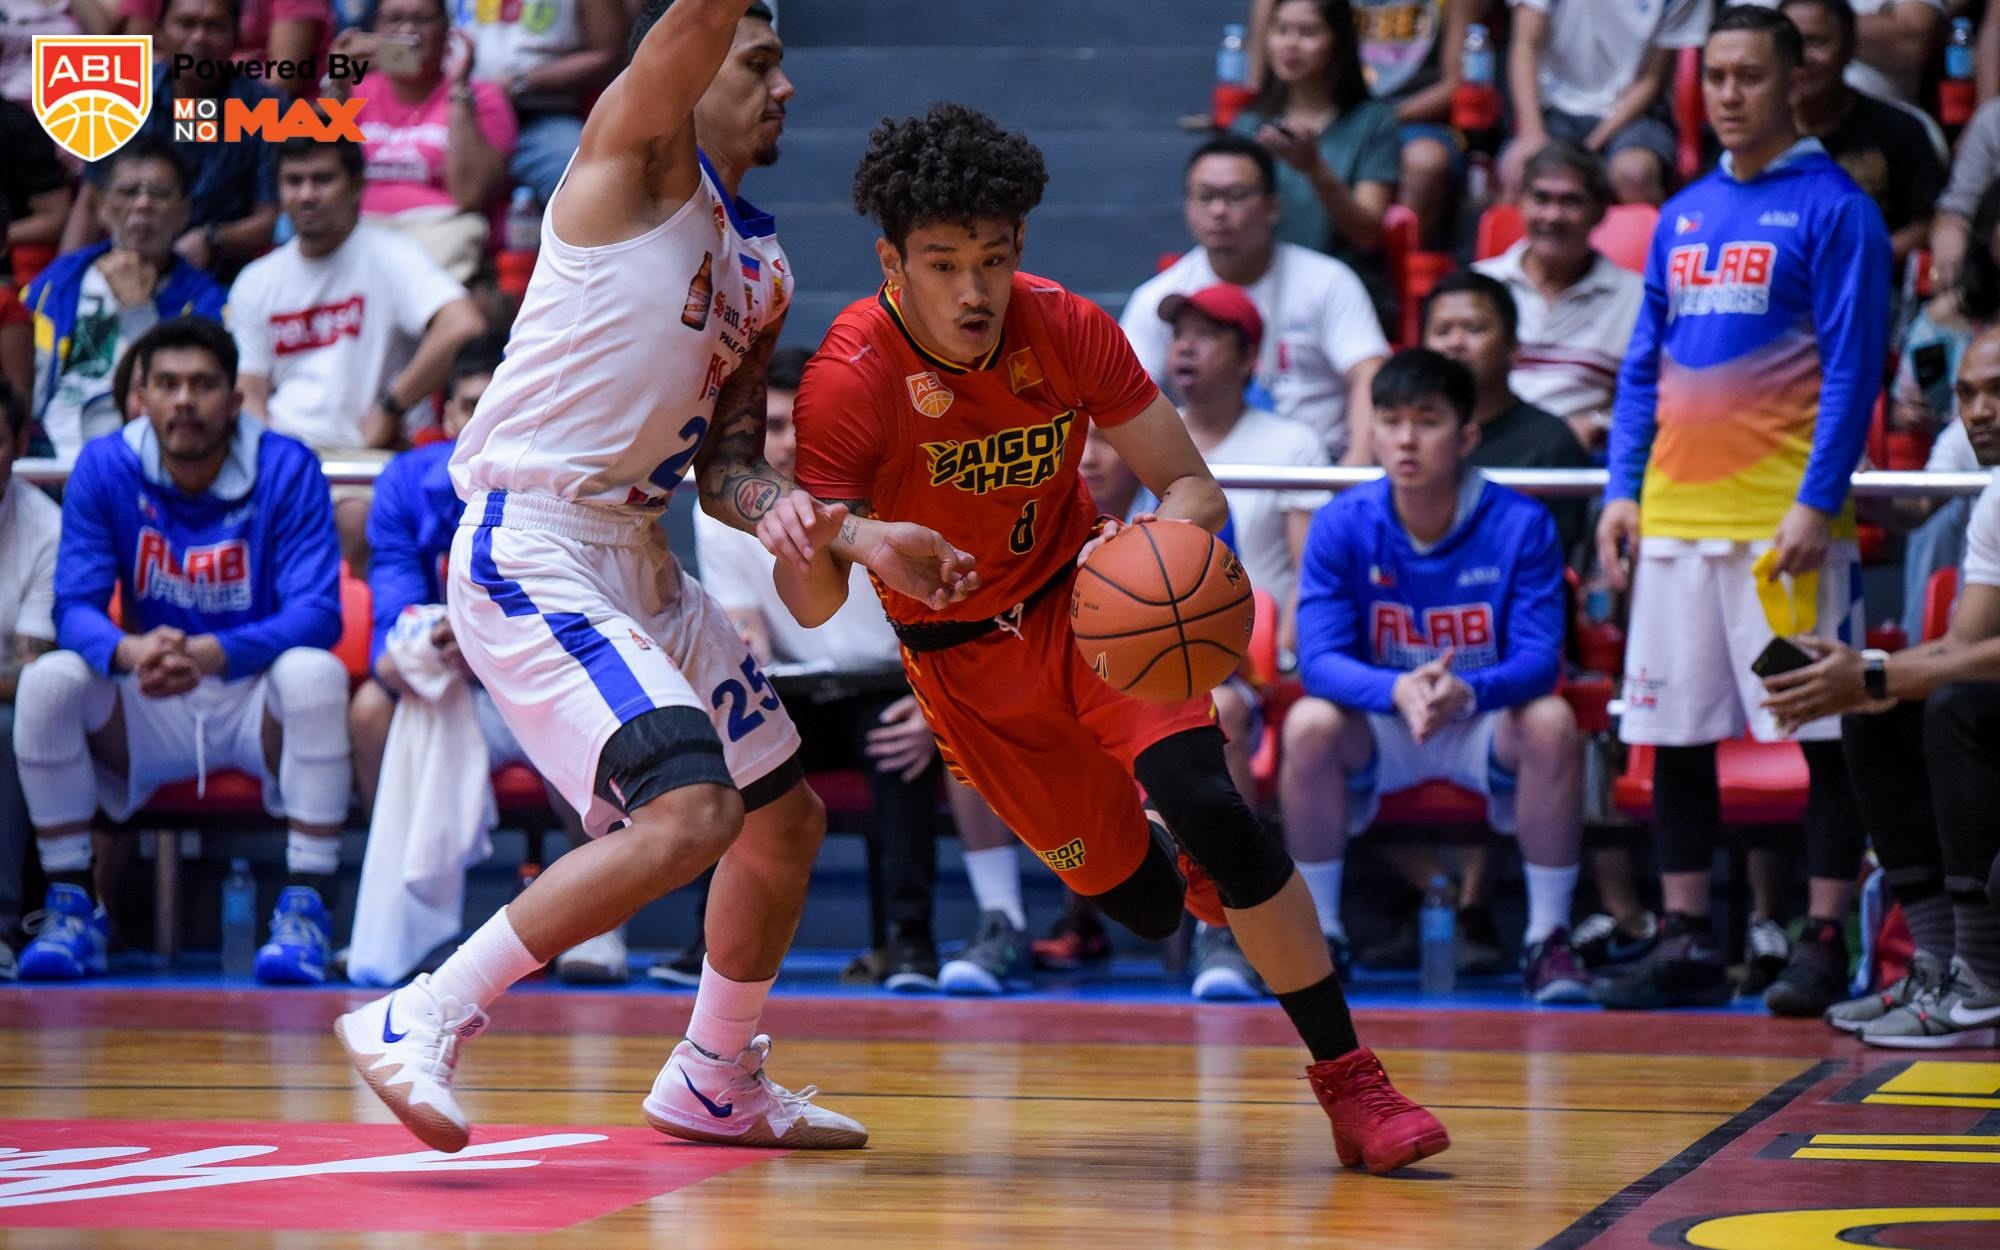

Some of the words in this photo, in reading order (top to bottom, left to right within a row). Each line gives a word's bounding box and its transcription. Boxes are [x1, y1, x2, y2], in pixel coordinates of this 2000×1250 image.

[1667, 242, 1776, 292] ALAB
[713, 290, 740, 330] San
[719, 331, 741, 353] PALE
[136, 526, 251, 594] ALAB
[1369, 601, 1496, 656] ALAB
[711, 652, 780, 743] 25
